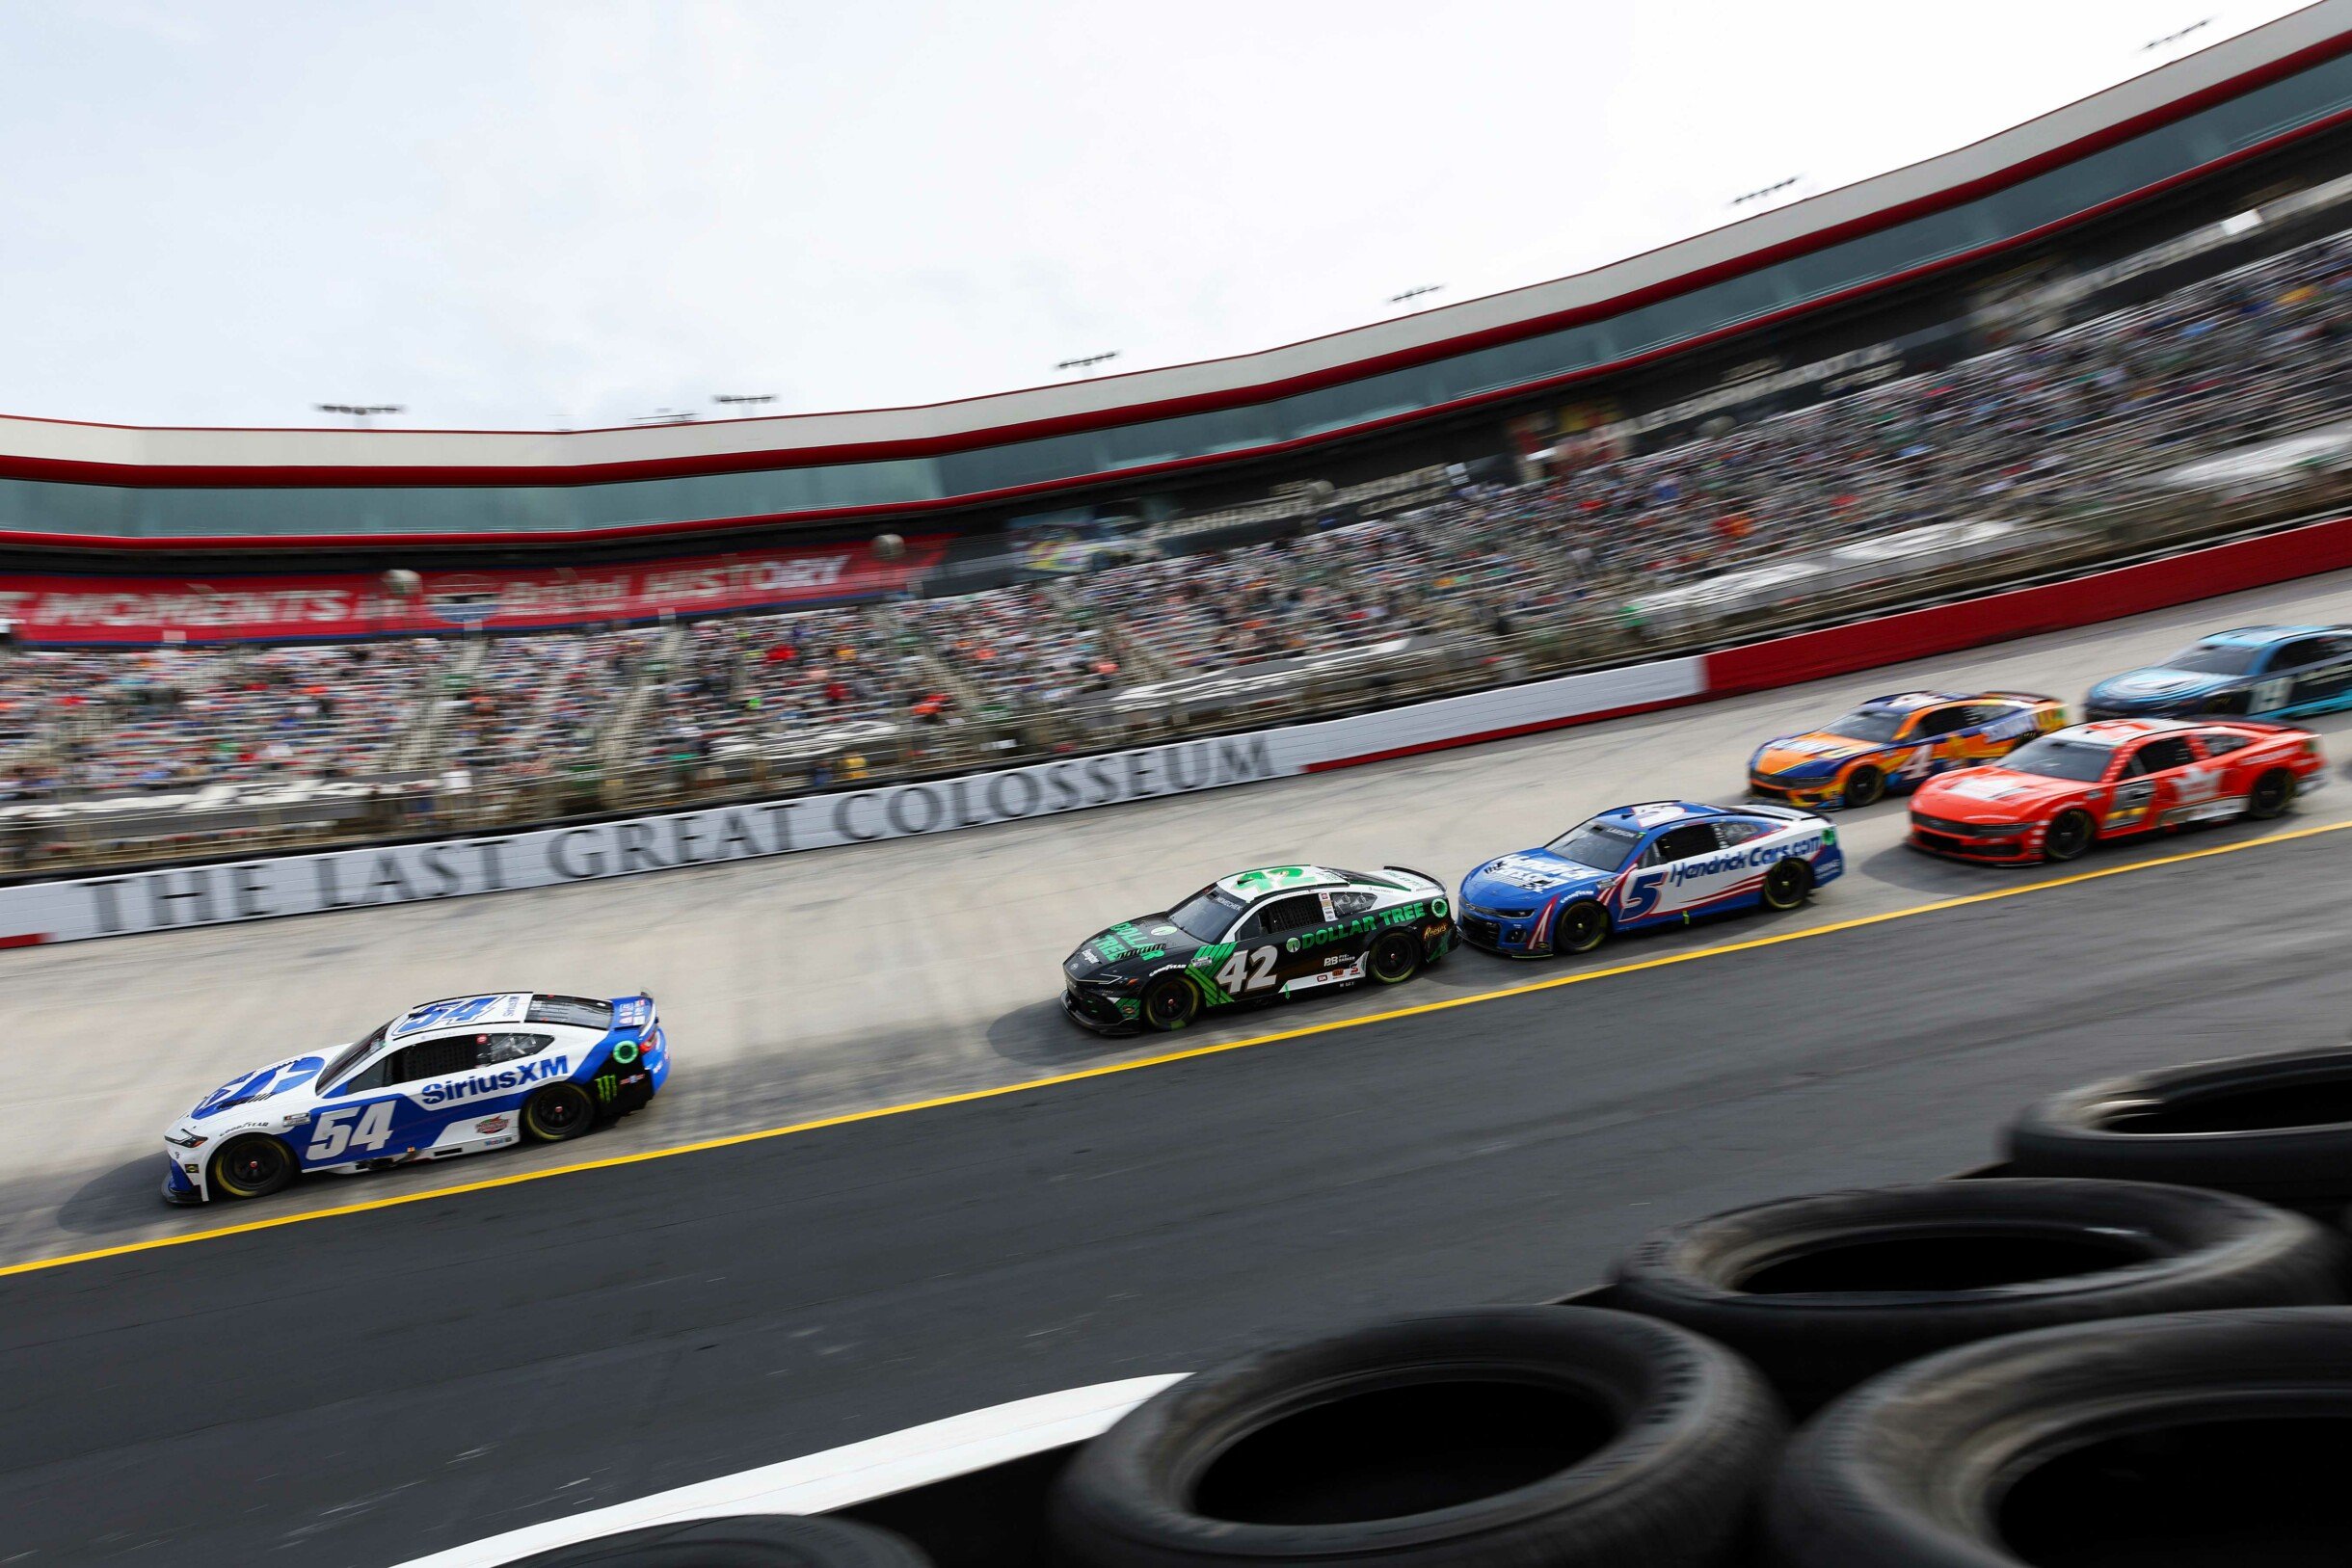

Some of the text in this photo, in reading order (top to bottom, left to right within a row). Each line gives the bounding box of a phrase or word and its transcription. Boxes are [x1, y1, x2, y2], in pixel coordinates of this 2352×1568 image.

[28, 591, 352, 626] MOMENTS
[642, 554, 851, 602] HISTORY
[1900, 743, 1935, 780] 4
[81, 737, 1277, 933] THE LAST GREAT COLOSSEUM
[1619, 870, 1669, 922] 5
[1302, 902, 1426, 949] DOLLAR TREE
[1216, 944, 1278, 994] 42
[397, 997, 501, 1033] 54
[421, 1055, 569, 1105] SiriusXM
[306, 1100, 397, 1160] 54
